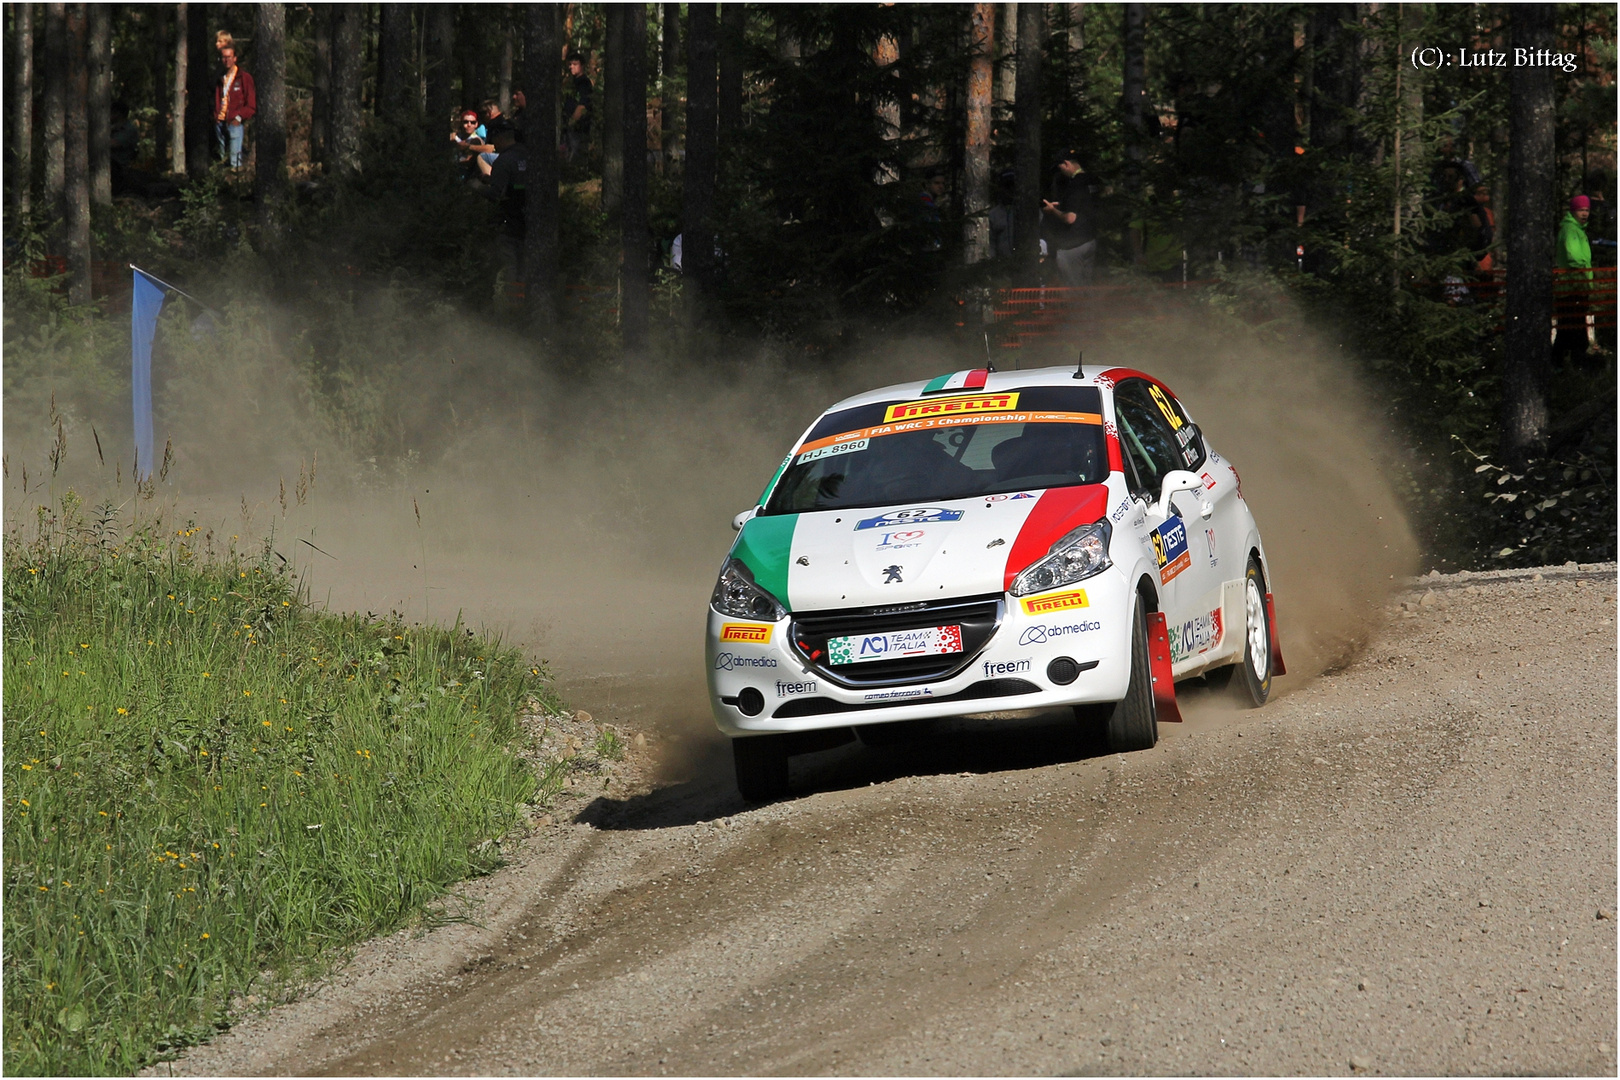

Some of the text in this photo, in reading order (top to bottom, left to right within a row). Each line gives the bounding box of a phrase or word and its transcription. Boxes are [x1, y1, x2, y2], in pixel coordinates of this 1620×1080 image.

[892, 395, 1011, 418] PIRELLI
[1148, 384, 1183, 430] 62
[871, 427, 891, 435] FIA
[895, 421, 923, 431] WRC
[938, 414, 1026, 425] Championship
[831, 440, 866, 454] 8960
[875, 516, 941, 526] NESTE
[897, 510, 927, 519] 62
[1152, 524, 1185, 566] 62 NESTE
[1027, 593, 1082, 612] PIRELLI
[723, 626, 767, 640] PIRELLI
[891, 633, 922, 642] TEAM
[860, 636, 888, 654] ACI
[889, 641, 926, 651] ITALIA
[983, 660, 1030, 675] freem
[776, 681, 817, 694] freem
